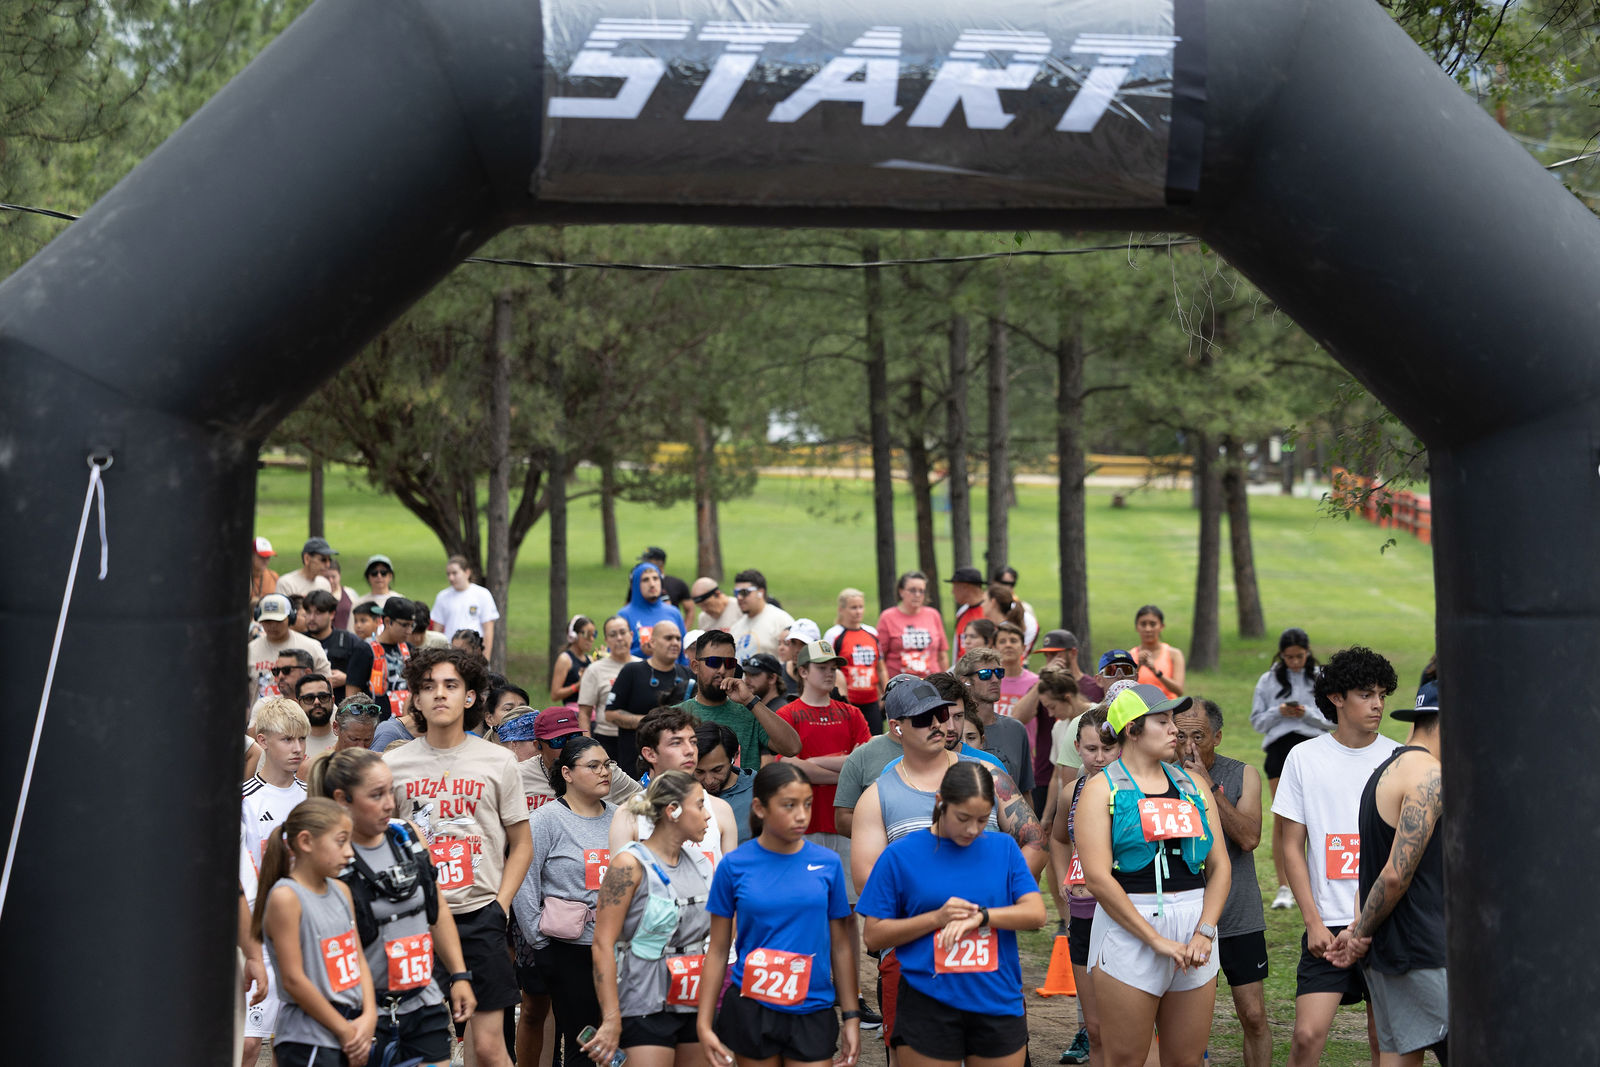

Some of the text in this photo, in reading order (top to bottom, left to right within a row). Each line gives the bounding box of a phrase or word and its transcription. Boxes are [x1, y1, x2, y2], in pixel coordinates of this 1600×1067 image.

[547, 18, 1181, 133] START
[406, 776, 485, 800] PIZZA HUT
[440, 797, 477, 819] RUN
[1152, 813, 1193, 836] 143
[944, 939, 989, 967] 225
[400, 954, 431, 984] 153
[750, 968, 798, 1000] 224
